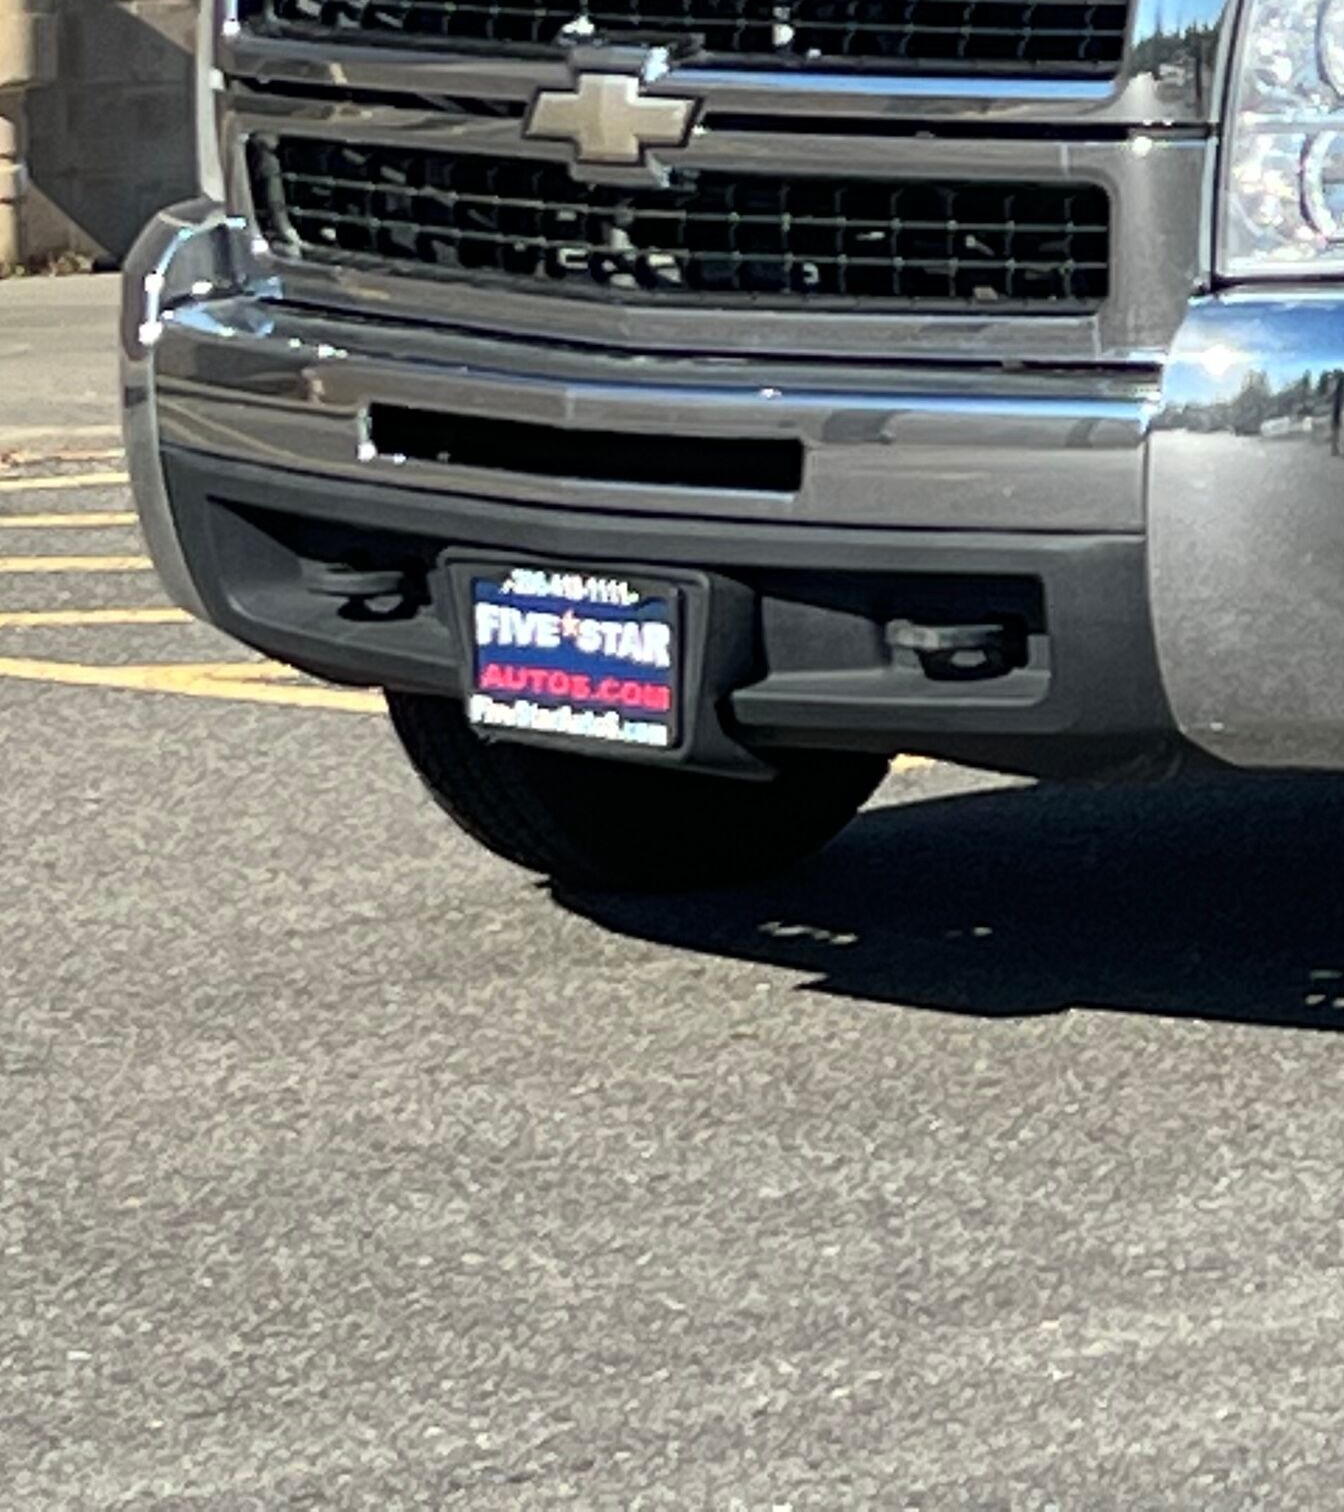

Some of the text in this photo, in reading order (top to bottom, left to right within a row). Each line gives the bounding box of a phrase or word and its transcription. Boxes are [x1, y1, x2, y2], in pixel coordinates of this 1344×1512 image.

[475, 602, 671, 668] FIVE STAR
[479, 662, 671, 711] AUTOS.COM
